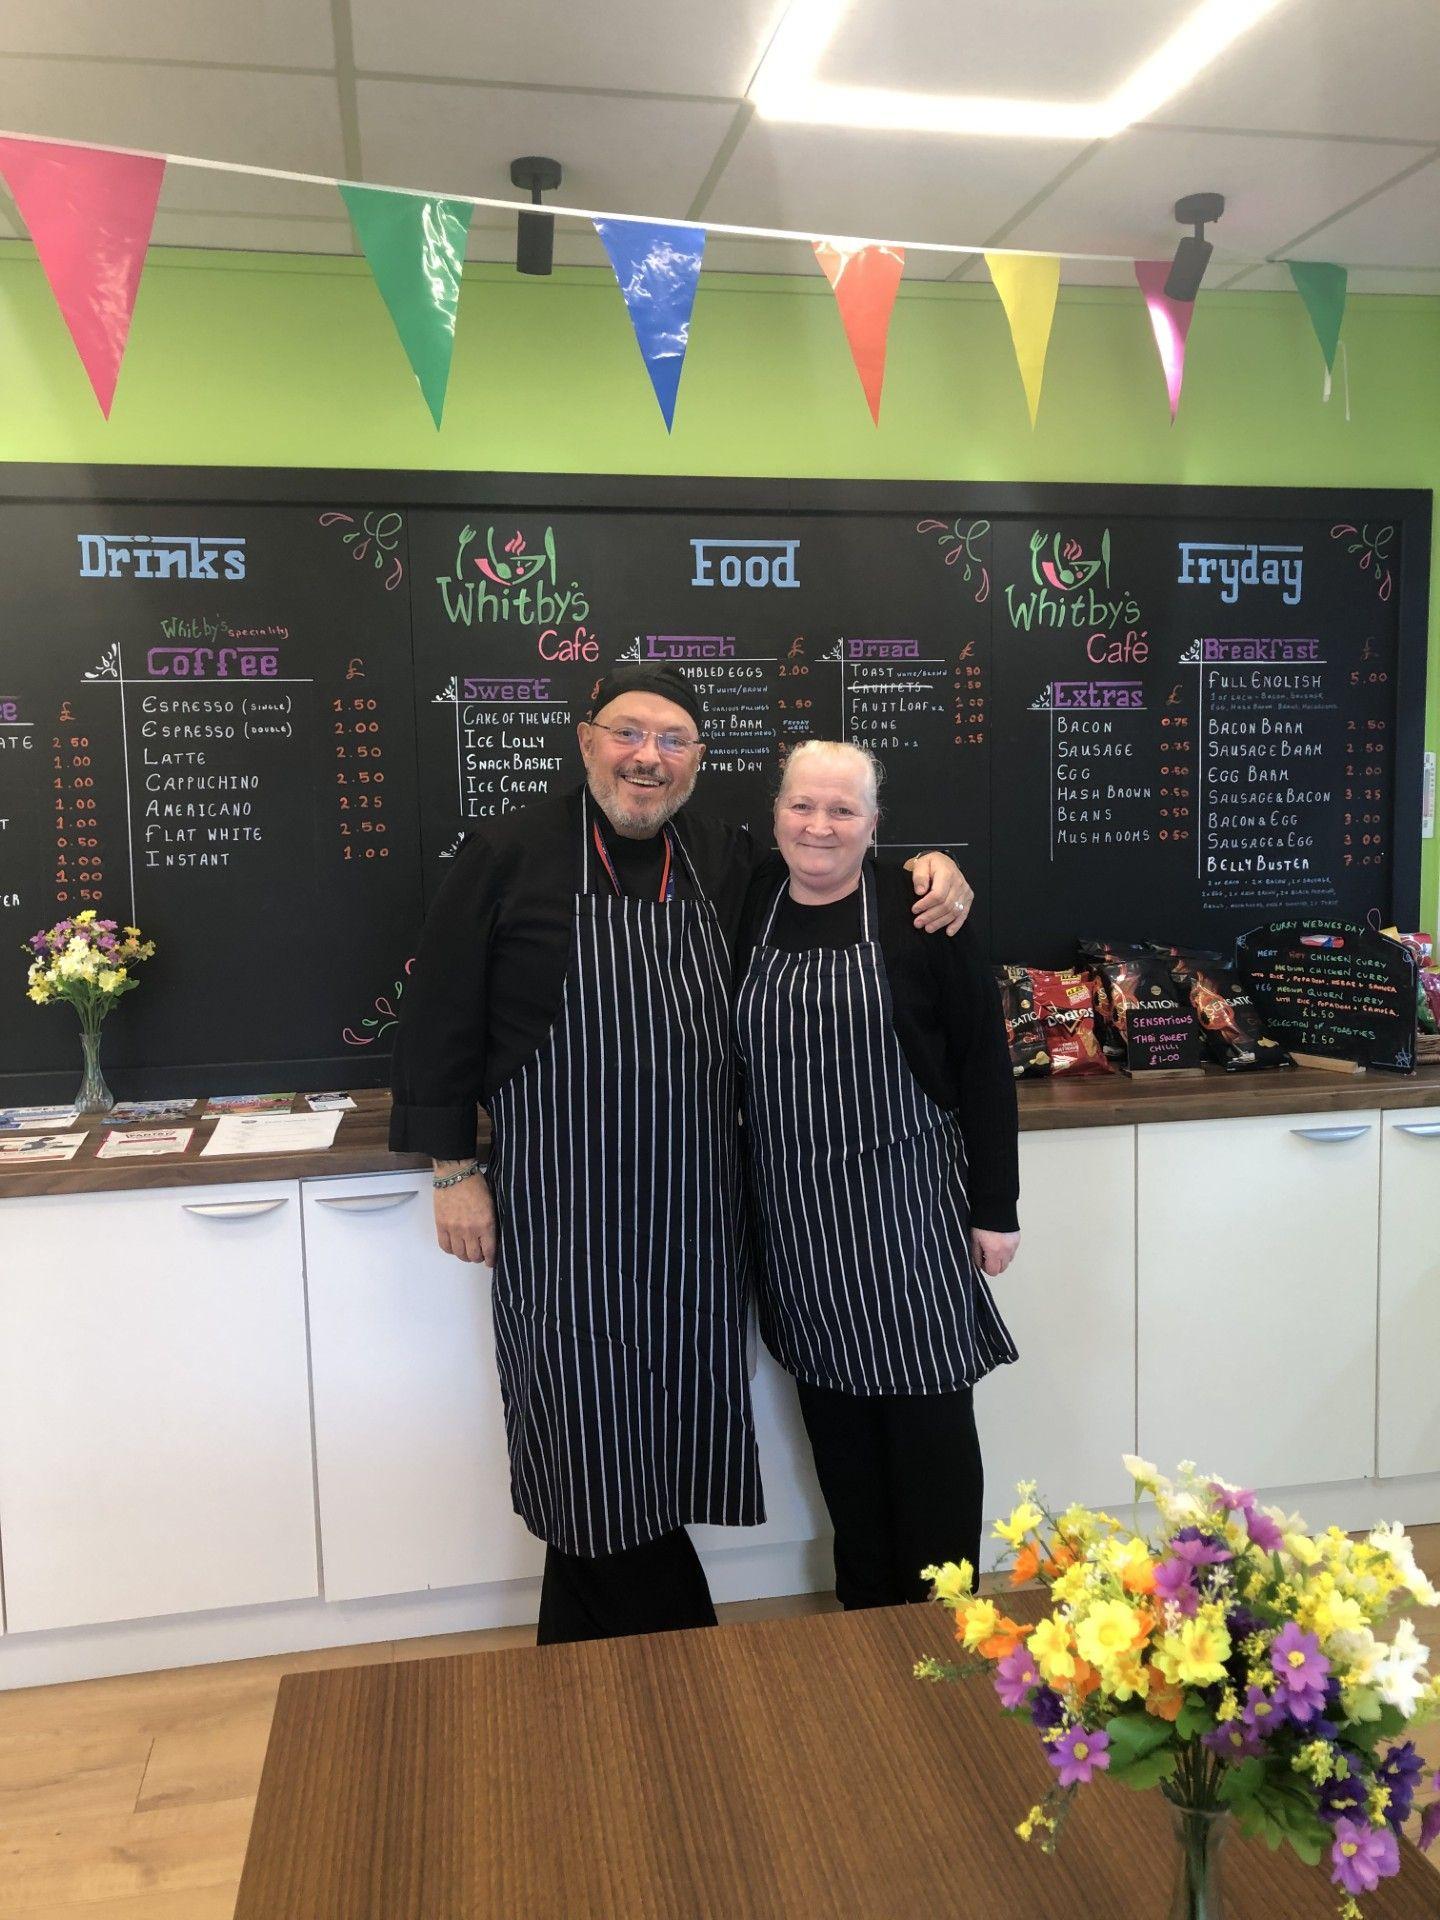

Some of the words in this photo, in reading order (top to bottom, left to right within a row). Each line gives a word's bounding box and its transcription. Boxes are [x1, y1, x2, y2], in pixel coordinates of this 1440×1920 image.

[77, 534, 246, 580] Drinks
[690, 538, 801, 588] Food
[1178, 543, 1303, 605] Fryday
[436, 576, 590, 626] Whitby's
[1005, 584, 1141, 631] Whitby's
[161, 614, 228, 642] Whitby's
[538, 627, 599, 663] Café
[646, 635, 736, 658] Lunch
[788, 637, 804, 658] £
[848, 639, 920, 657] Bread
[1087, 631, 1149, 664] Café
[1205, 638, 1319, 662] Breakfast
[147, 647, 280, 677] Coffee
[346, 658, 365, 680] £
[729, 667, 763, 678] EGGS
[779, 665, 809, 677] 2.00
[850, 663, 894, 677] TOAST
[1209, 671, 1247, 688] FULL
[1251, 670, 1322, 688] ENGLISH
[464, 678, 551, 700] Sweet
[1053, 681, 1143, 707] Extras
[59, 701, 76, 722] £
[142, 695, 233, 713] ESPRESSO
[333, 699, 377, 712] 1.50
[852, 698, 896, 713] FRUIT
[900, 698, 929, 712] LOAF
[463, 704, 500, 726] CAKE
[502, 712, 515, 725] OF
[520, 712, 539, 725] THE
[541, 711, 571, 725] WEEK
[851, 715, 897, 731] SCONE
[142, 720, 234, 738] ESPRESSO
[335, 722, 379, 735] 2.00
[1058, 716, 1113, 734] BACON
[1209, 719, 1257, 734] BACON
[1261, 718, 1304, 734] BARM
[465, 729, 494, 748] ICE
[502, 731, 545, 748] LOLLY
[144, 748, 206, 766] LATTE
[336, 746, 382, 758] 2.50
[1058, 741, 1134, 758] SAUSAGE
[1208, 741, 1277, 757] SAUSAGE
[1281, 740, 1322, 757] BARM
[54, 756, 91, 769] 1.00
[466, 753, 511, 771] SNACK
[514, 753, 562, 771] BASKET
[711, 762, 733, 772] THE
[737, 758, 762, 772] DAY
[1058, 764, 1091, 781] EGG
[1208, 767, 1239, 784] EGG
[1248, 765, 1289, 782] BARM
[54, 777, 94, 789] 1.00
[145, 774, 260, 792] CAPPUCHINO
[336, 772, 384, 785] 2.50
[467, 777, 494, 793] ICE
[501, 775, 548, 793] CREAM
[1058, 786, 1100, 801] HASH
[1107, 785, 1152, 800] BROWN
[1209, 789, 1275, 804] SAUSAGE
[1286, 788, 1331, 803] BACON
[55, 798, 96, 811] 1.00
[145, 799, 252, 818] AMERICANO
[339, 795, 383, 809] 2.25
[468, 798, 495, 817] ICE
[56, 816, 97, 829] 1.00
[1058, 806, 1113, 822] BEANS
[1208, 812, 1256, 829] BACON
[1270, 810, 1298, 827] EGG
[145, 824, 199, 842] FLAT
[208, 826, 262, 842] WHITE
[340, 821, 386, 836] 2.50
[1058, 829, 1151, 845] MUSHROOMS
[1208, 832, 1274, 849] SAUSAGE
[1287, 832, 1314, 848] EGG
[57, 837, 98, 848] 0.50
[58, 854, 102, 866] 1.00
[146, 850, 231, 867] INSTANT
[344, 846, 390, 860] 1.00
[1207, 856, 1252, 872] BELLY
[1257, 854, 1310, 871] BUSTER
[56, 869, 103, 882] 1.00
[56, 889, 103, 902] 0.50
[1270, 920, 1297, 932] CURRY
[1355, 958, 1387, 968] CURRY
